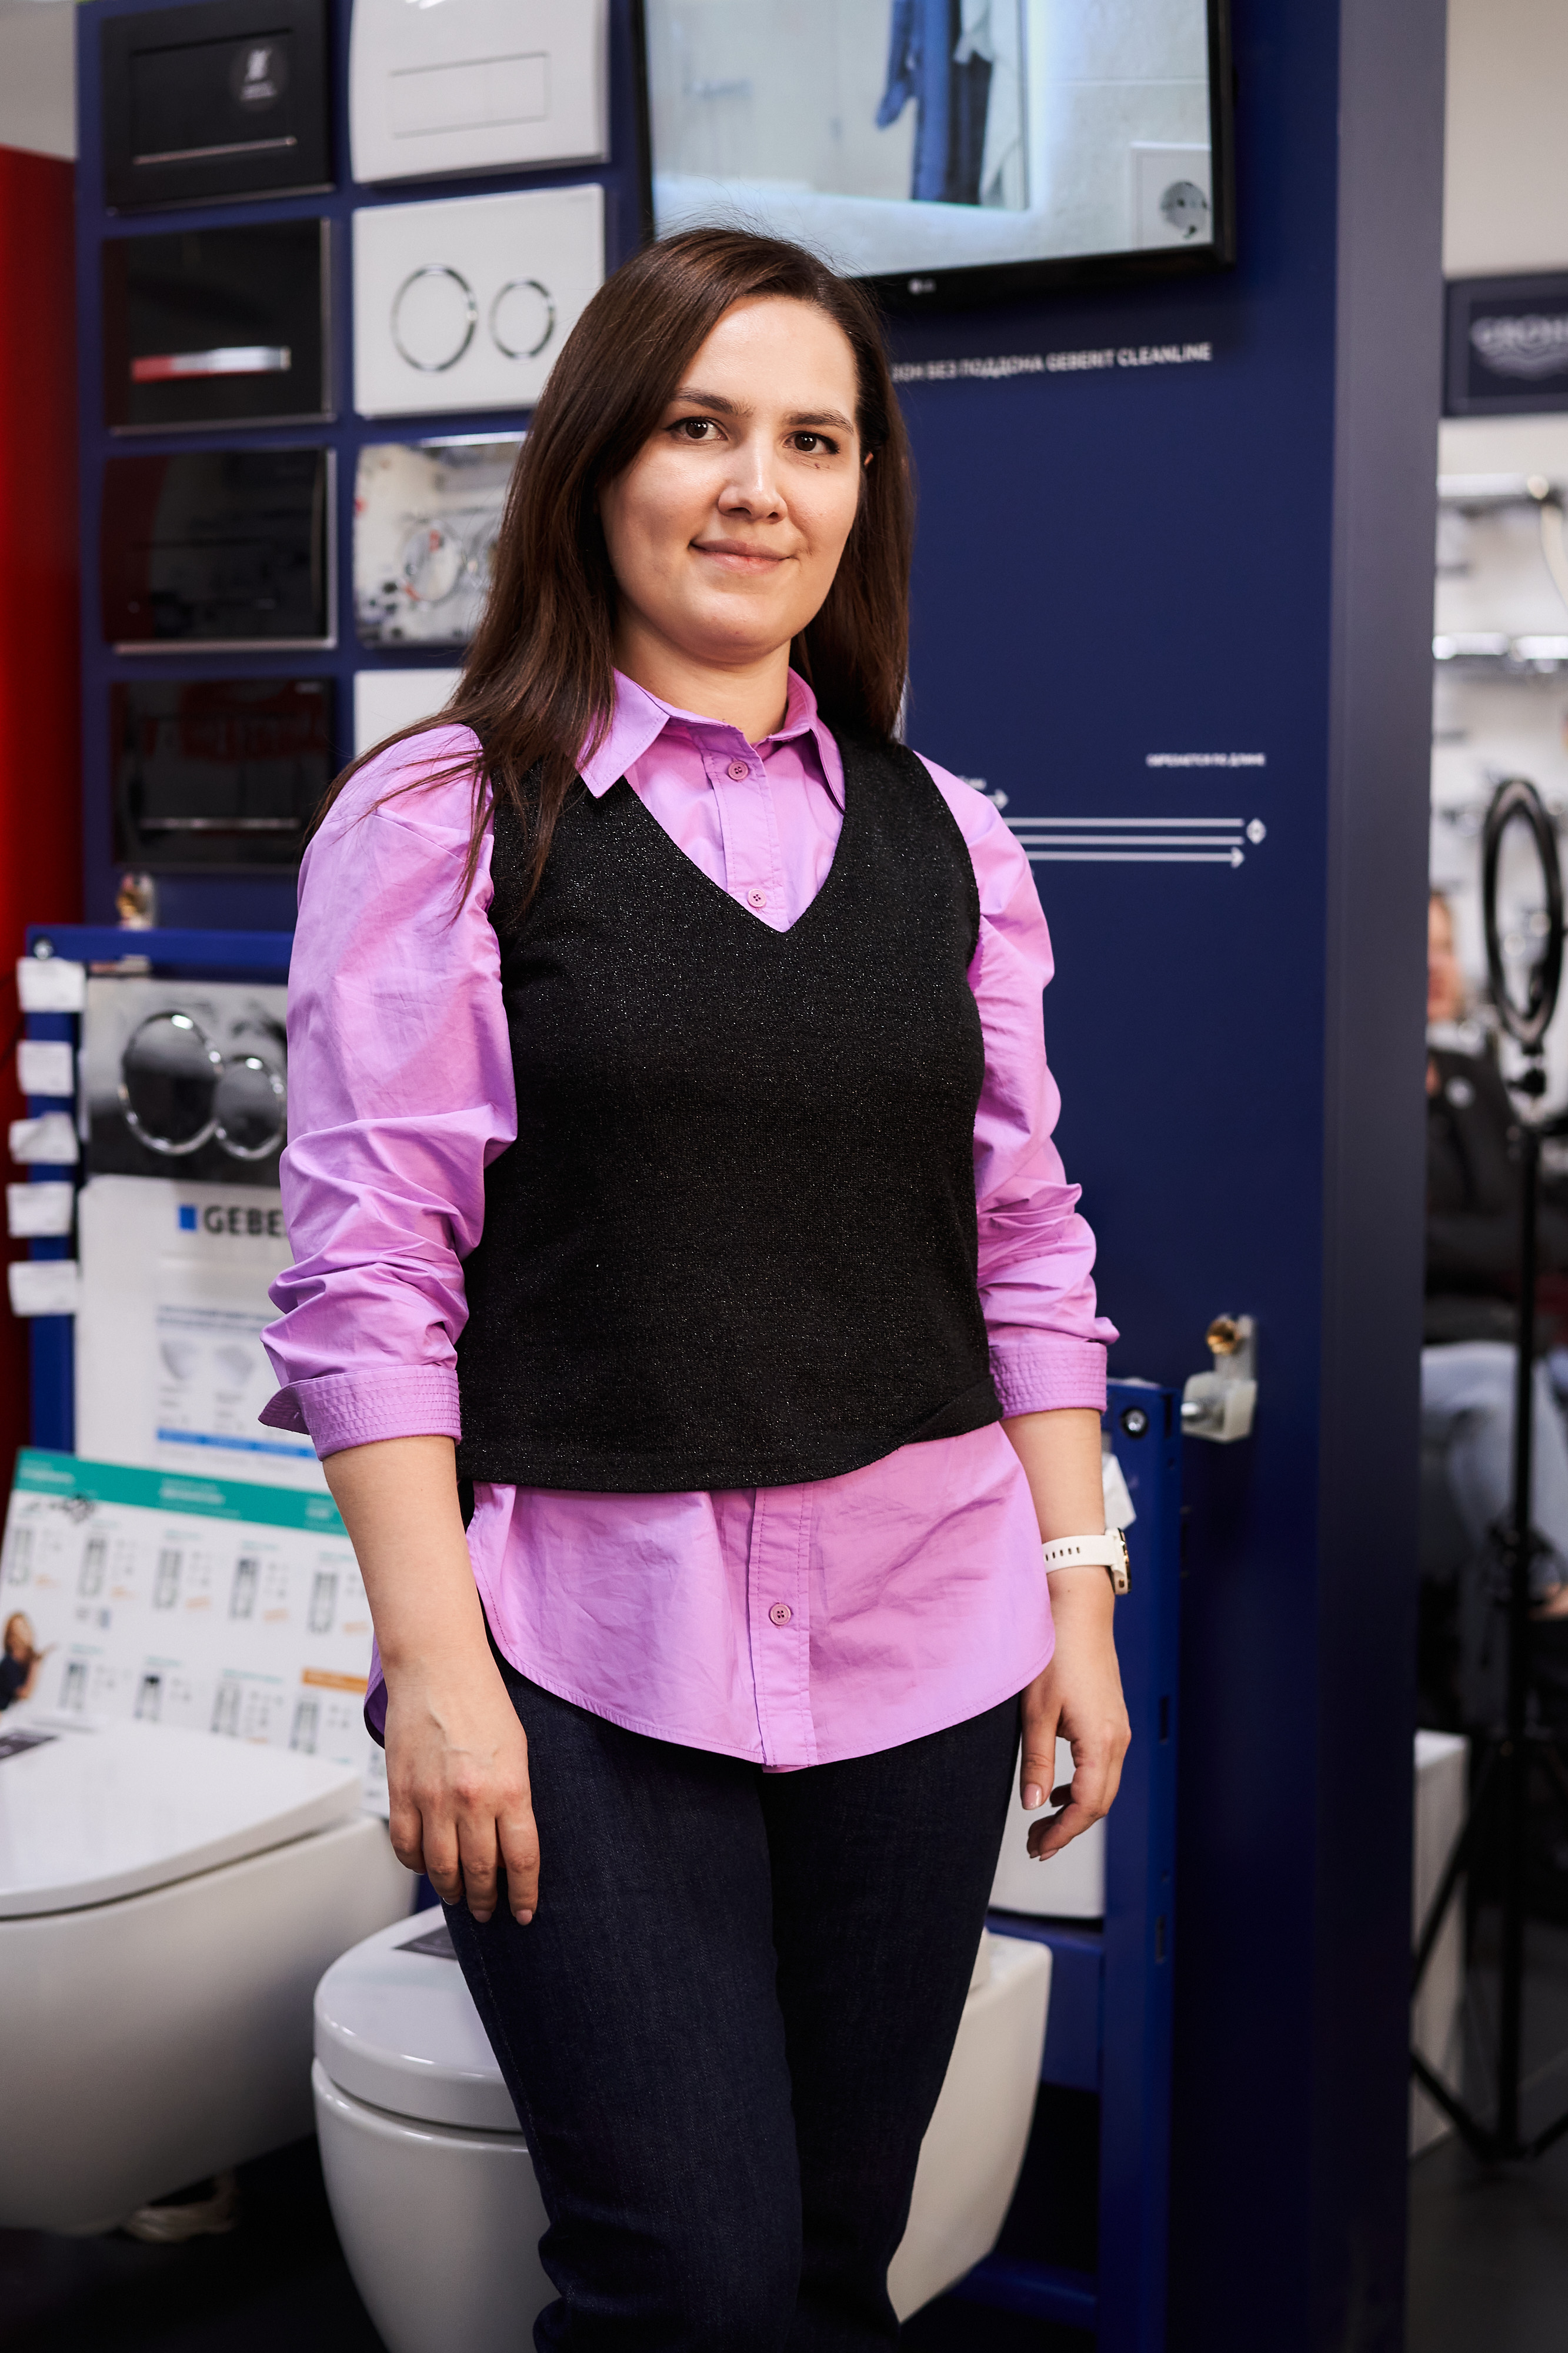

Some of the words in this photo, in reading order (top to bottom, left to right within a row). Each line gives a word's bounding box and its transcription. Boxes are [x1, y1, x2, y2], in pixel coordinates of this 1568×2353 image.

[928, 359, 957, 379] БЕЗ
[959, 355, 1043, 378] ПОДДОНА
[1046, 348, 1114, 372] GEBERIT
[1117, 342, 1211, 367] CLEANLINE
